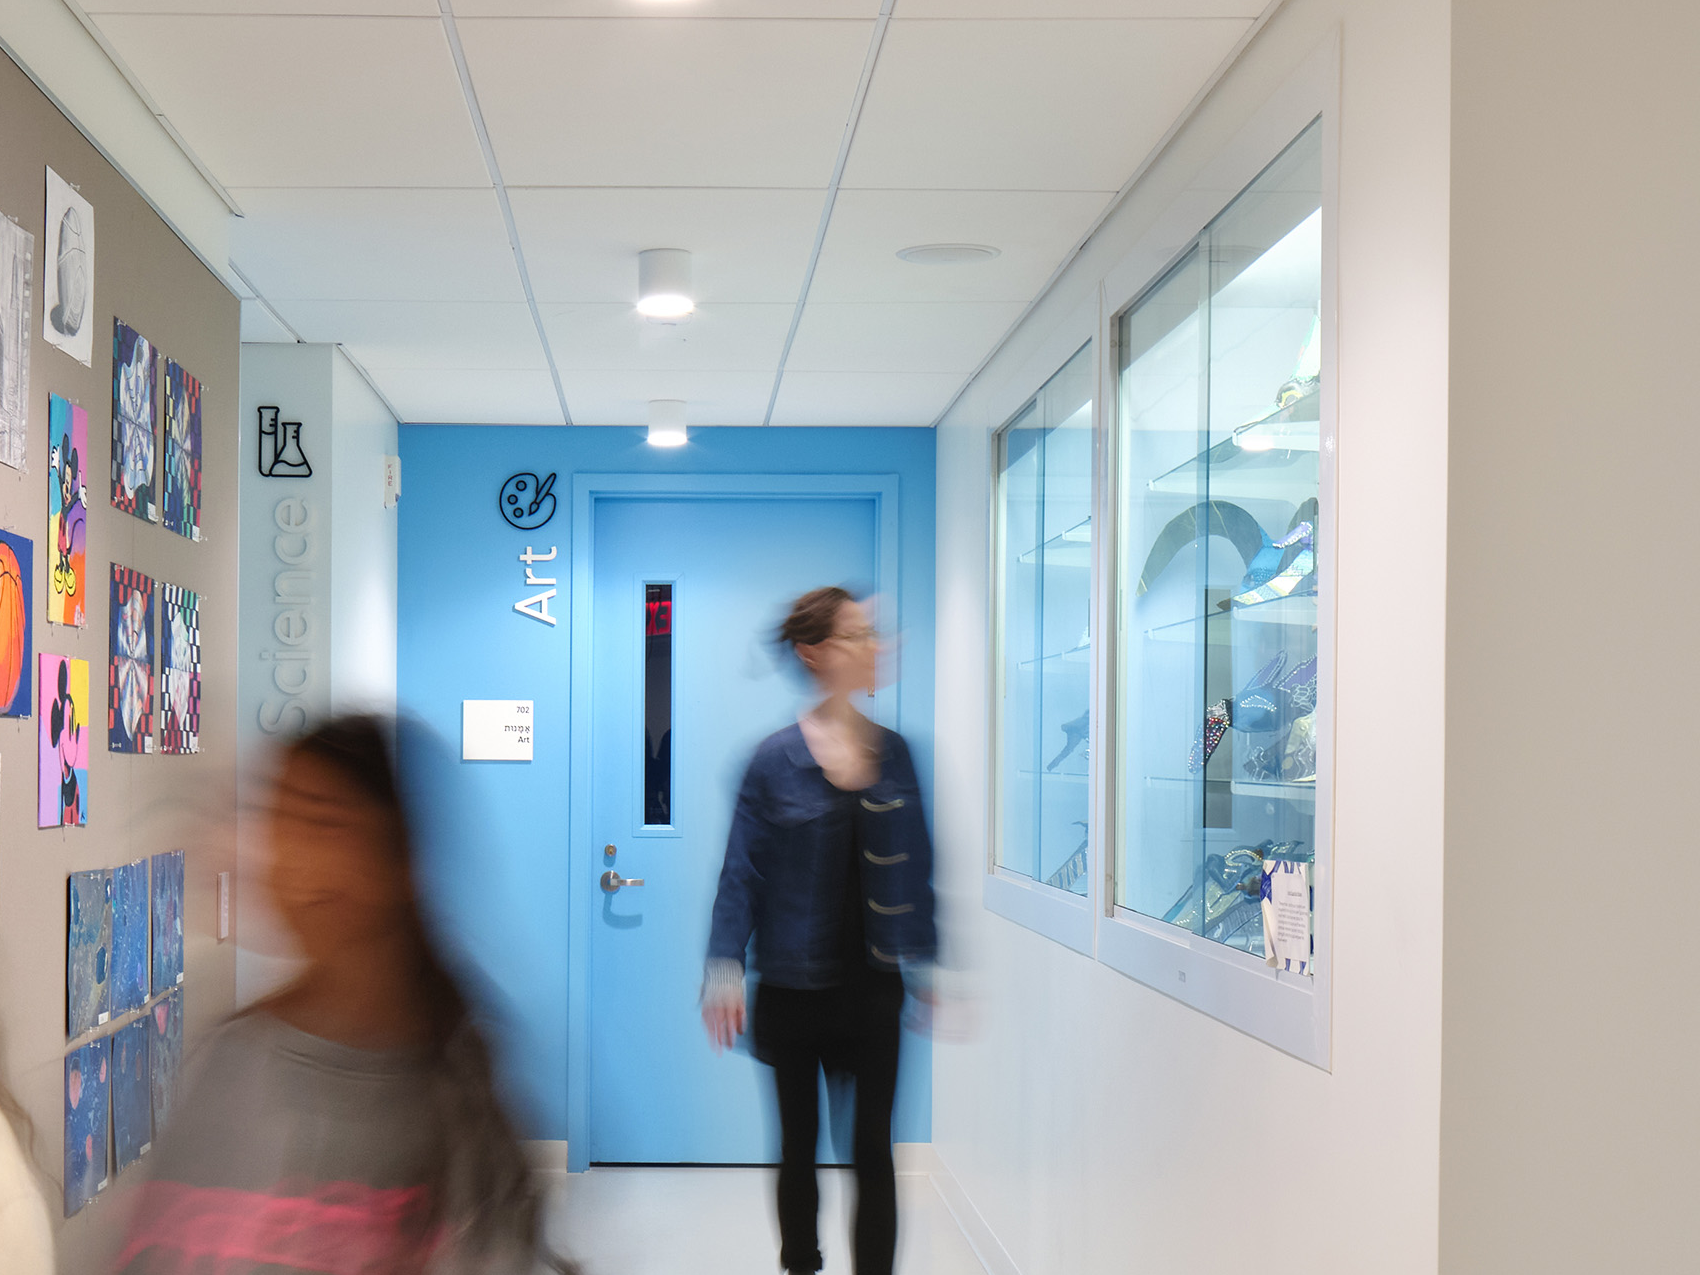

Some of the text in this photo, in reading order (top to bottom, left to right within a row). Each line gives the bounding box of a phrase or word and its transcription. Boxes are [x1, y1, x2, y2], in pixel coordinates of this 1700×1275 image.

[257, 497, 310, 736] Science
[514, 546, 557, 626] Art
[516, 706, 530, 714] 702
